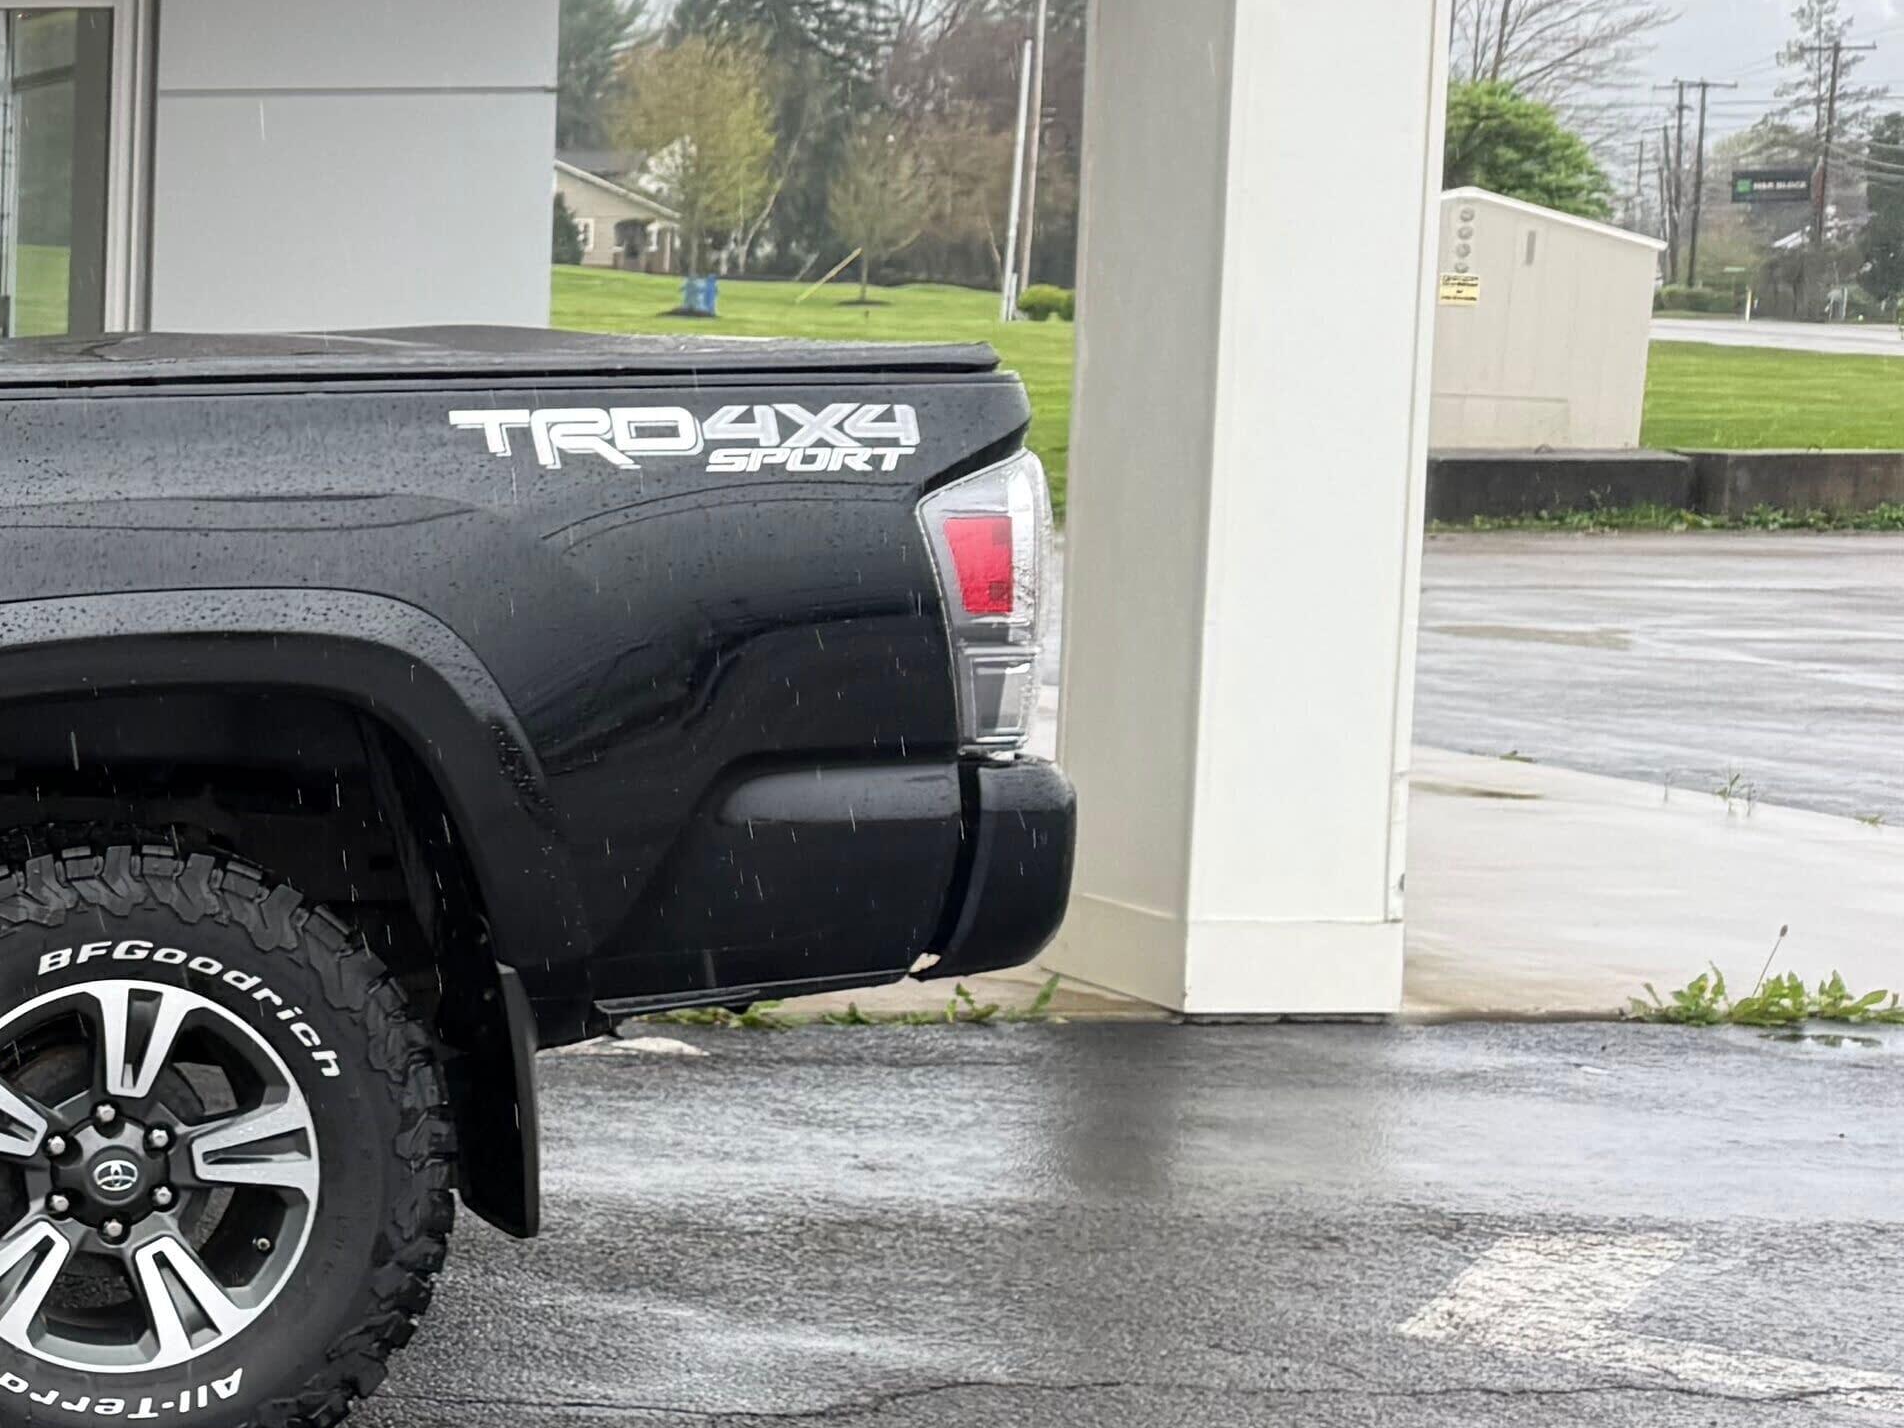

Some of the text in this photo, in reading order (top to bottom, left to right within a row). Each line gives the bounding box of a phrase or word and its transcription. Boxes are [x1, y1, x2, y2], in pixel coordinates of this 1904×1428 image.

[449, 406, 703, 470] TRD
[706, 446, 917, 473] SPORT
[37, 939, 342, 1078] BFGoodrich
